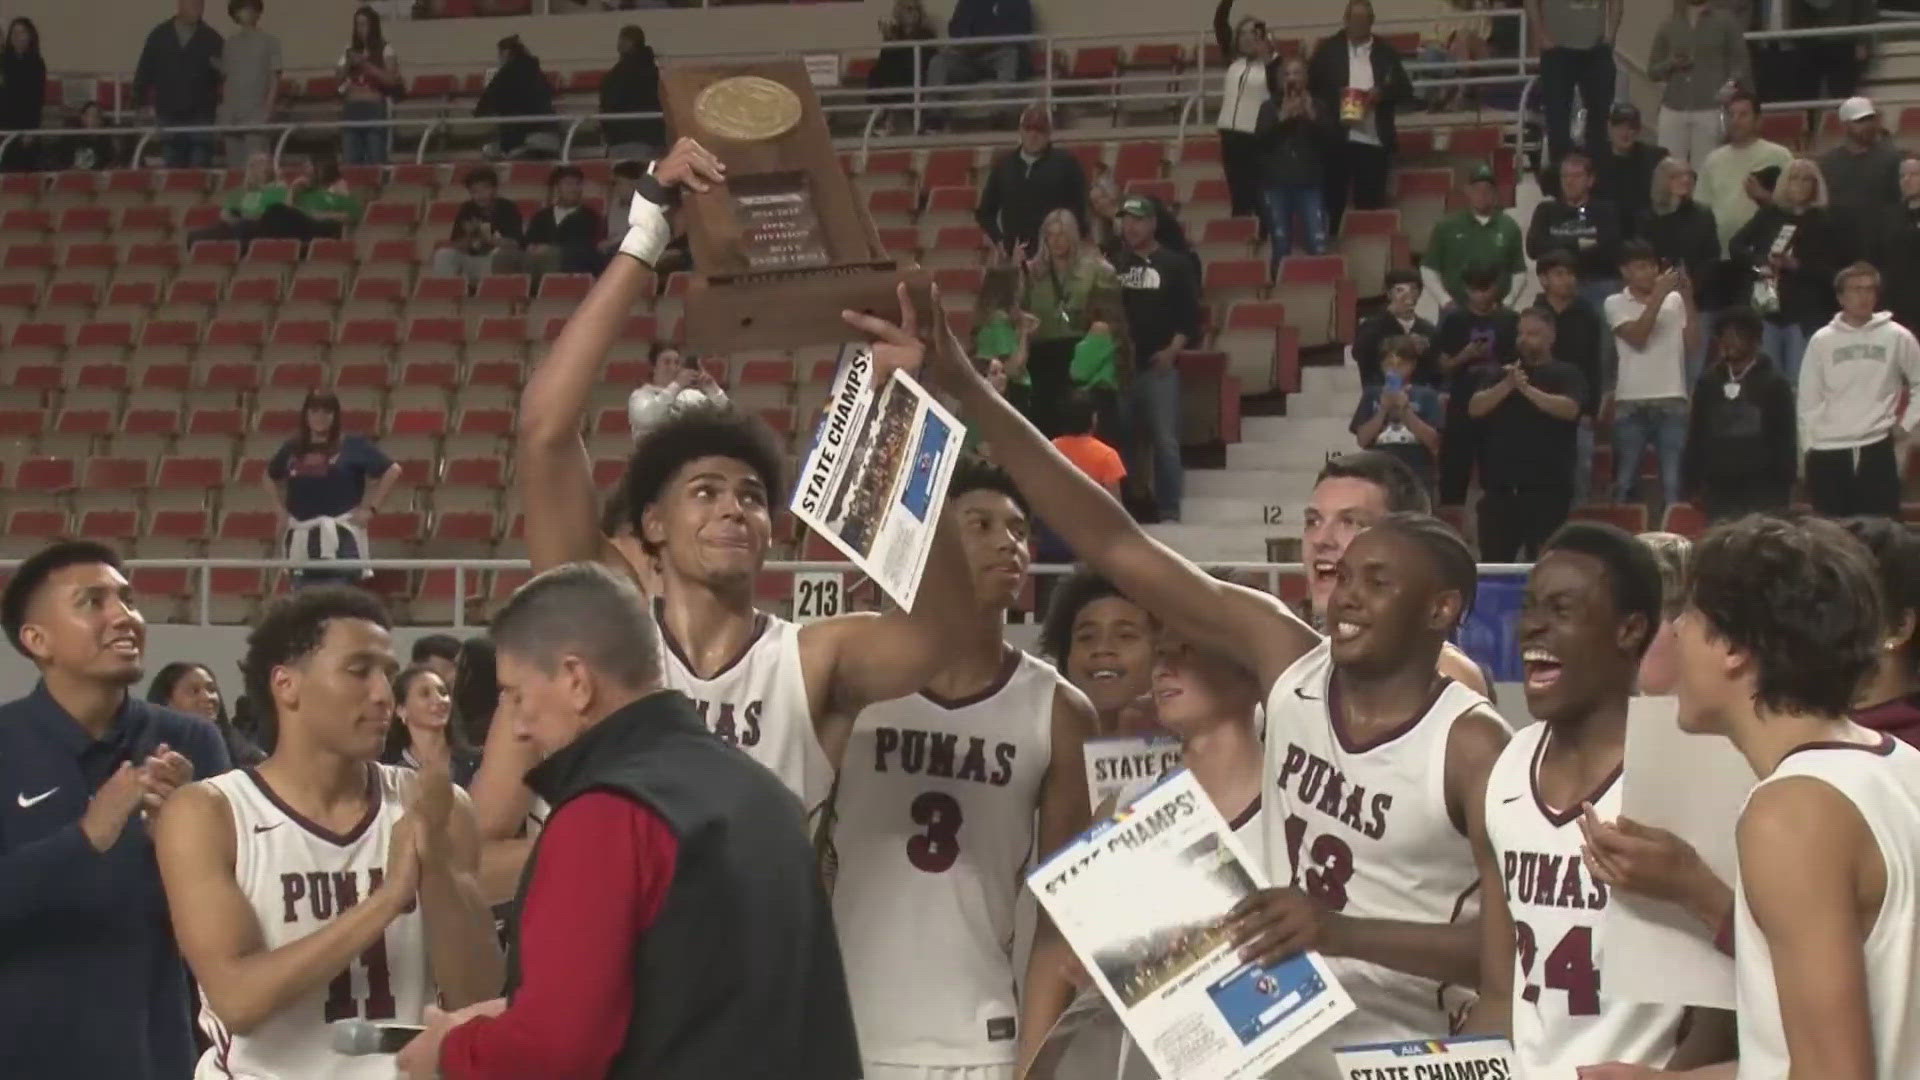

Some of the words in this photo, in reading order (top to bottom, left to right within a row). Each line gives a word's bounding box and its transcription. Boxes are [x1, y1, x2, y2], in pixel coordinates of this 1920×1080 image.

[802, 445, 835, 513] STATE
[828, 349, 870, 446] CHAMPS!
[1263, 505, 1282, 524] 12
[799, 579, 838, 616] 213
[874, 726, 1017, 786] PUMAS
[1095, 753, 1156, 782] STATE
[1276, 742, 1393, 840] PUMAS
[906, 791, 963, 873] 3
[1284, 813, 1354, 912] 13
[1503, 849, 1610, 911] PUMAS
[1515, 920, 1601, 1016] 24
[1402, 1045, 1424, 1056] AIA
[1414, 1058, 1512, 1080] CHAMPS!
